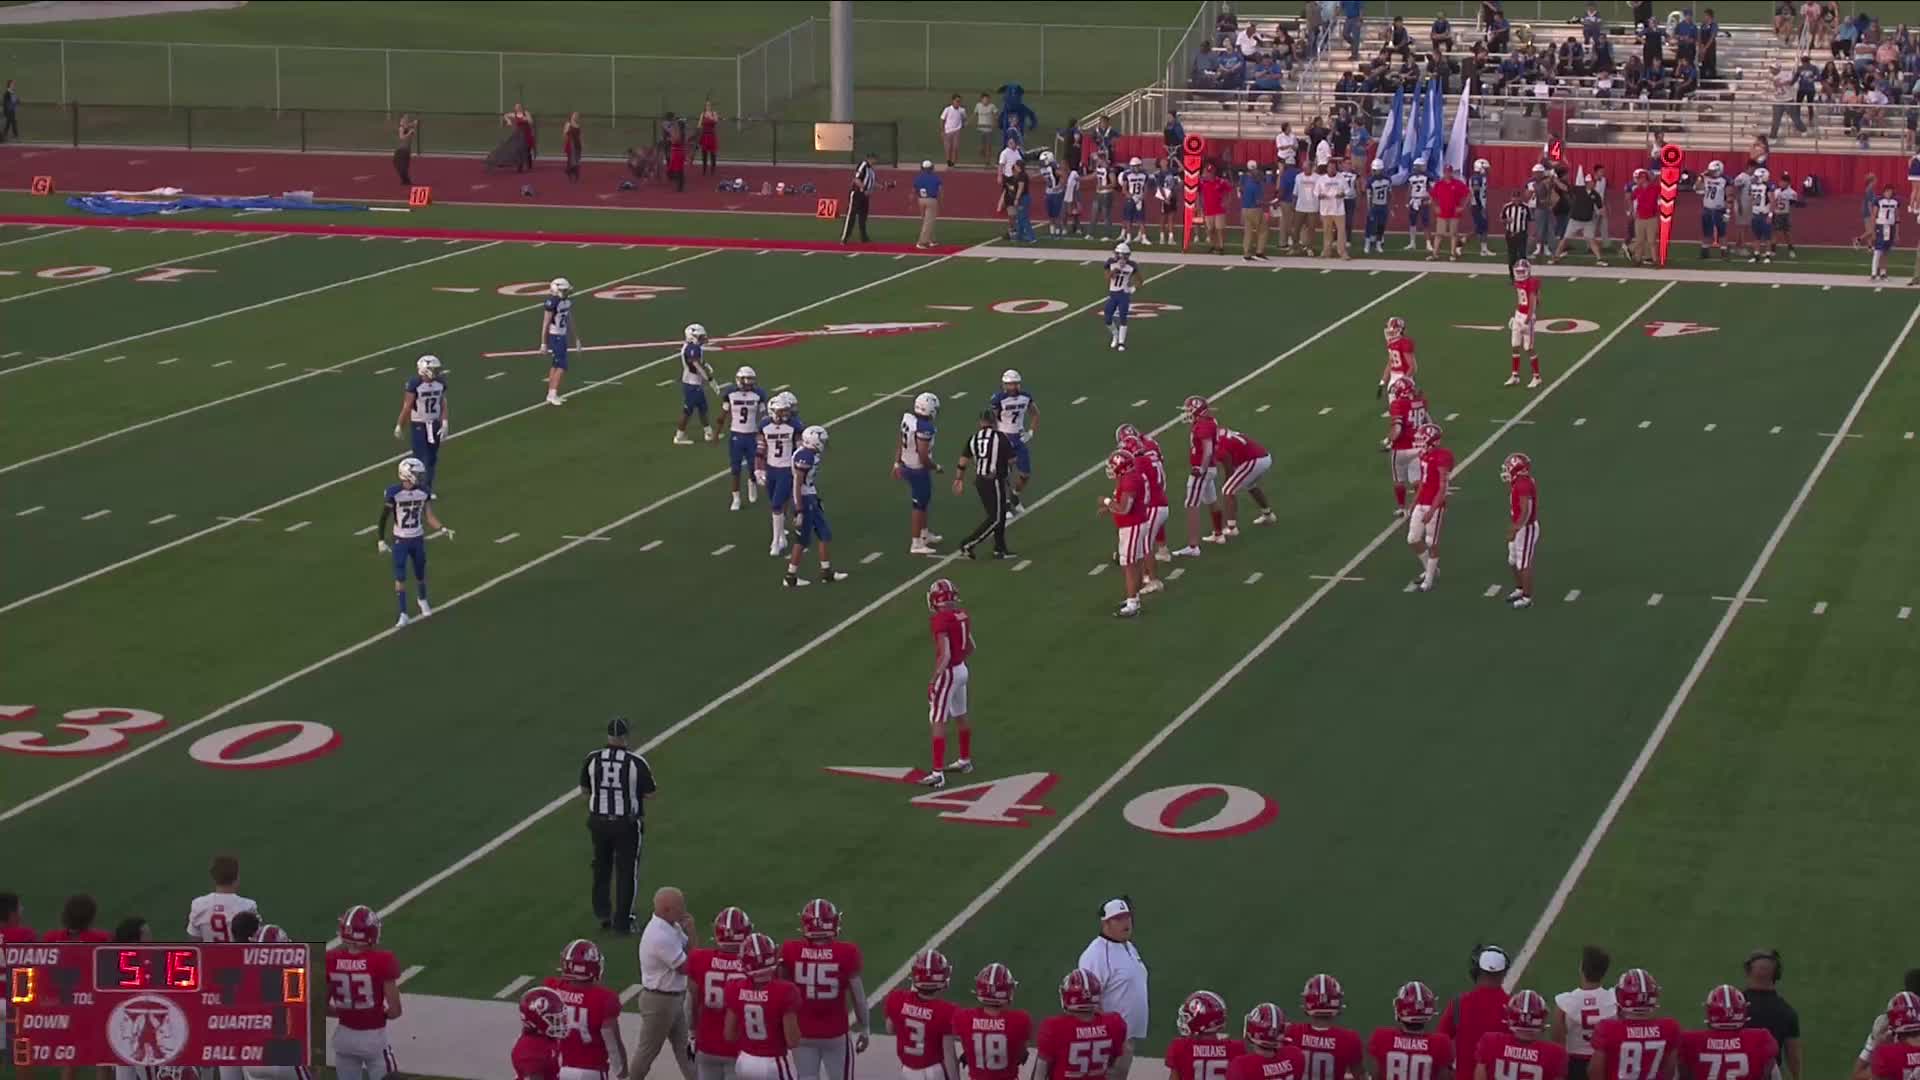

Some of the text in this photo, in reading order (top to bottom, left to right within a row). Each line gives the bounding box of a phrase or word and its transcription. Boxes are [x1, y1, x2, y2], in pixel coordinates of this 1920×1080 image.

[35, 177, 48, 192] G
[818, 200, 836, 216] 20
[425, 397, 437, 414] 12
[739, 406, 749, 424] 9
[1011, 411, 1020, 423] 7
[774, 440, 783, 458] 5
[977, 438, 989, 458] U
[601, 761, 623, 789] H
[801, 948, 833, 960] INDIANS
[336, 958, 368, 971] INDIANS
[795, 961, 840, 999] 45
[330, 973, 376, 1010] 33
[559, 988, 585, 1004] DIANS
[738, 988, 769, 1002] INDIANS
[901, 1002, 933, 1020] INDIANS
[743, 1004, 768, 1041] 8
[972, 1018, 1006, 1031] INDIANS
[903, 1021, 926, 1056] 3
[1076, 1024, 1107, 1039] INDIANS
[1626, 1026, 1660, 1039] INDIANS
[1302, 1033, 1336, 1050] INDIANS
[1393, 1036, 1429, 1051] INDIANS
[1706, 1038, 1741, 1050] INDIANS
[971, 1033, 1008, 1071] 18
[1064, 1039, 1113, 1078] 55
[1193, 1044, 1226, 1057] INDIANS
[1504, 1045, 1539, 1062] INDIANS
[1262, 1059, 1293, 1077] INDIANS
[1386, 1051, 1433, 1080] 80
[1617, 1040, 1667, 1080] 87
[1699, 1053, 1749, 1080] 72
